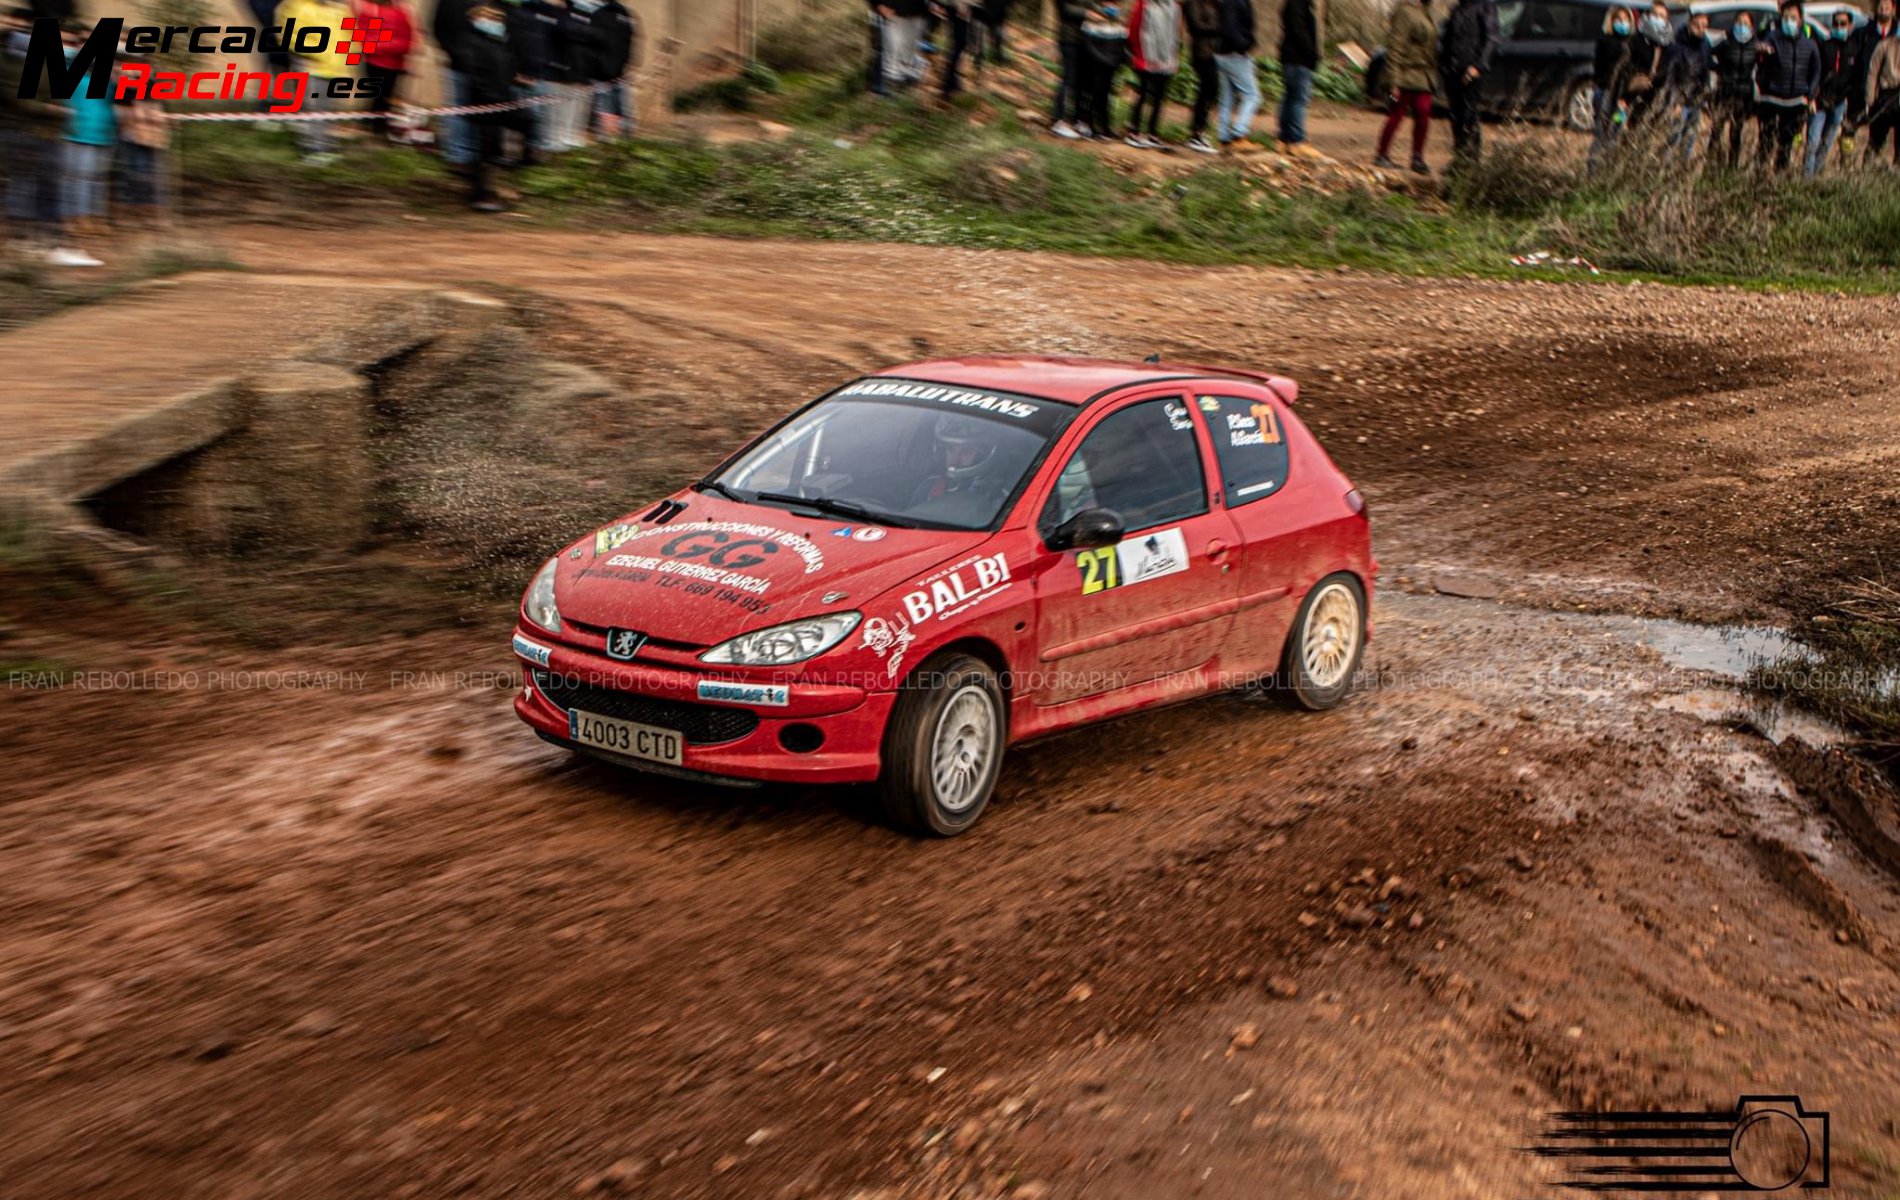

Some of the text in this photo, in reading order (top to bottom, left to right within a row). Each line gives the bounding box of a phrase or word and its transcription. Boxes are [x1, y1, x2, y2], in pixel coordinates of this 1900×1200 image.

[605, 554, 663, 570] EZEQUIEL
[775, 531, 825, 574] REFORMAS
[1077, 544, 1117, 596] 27
[583, 717, 676, 759] 4003 CTD
